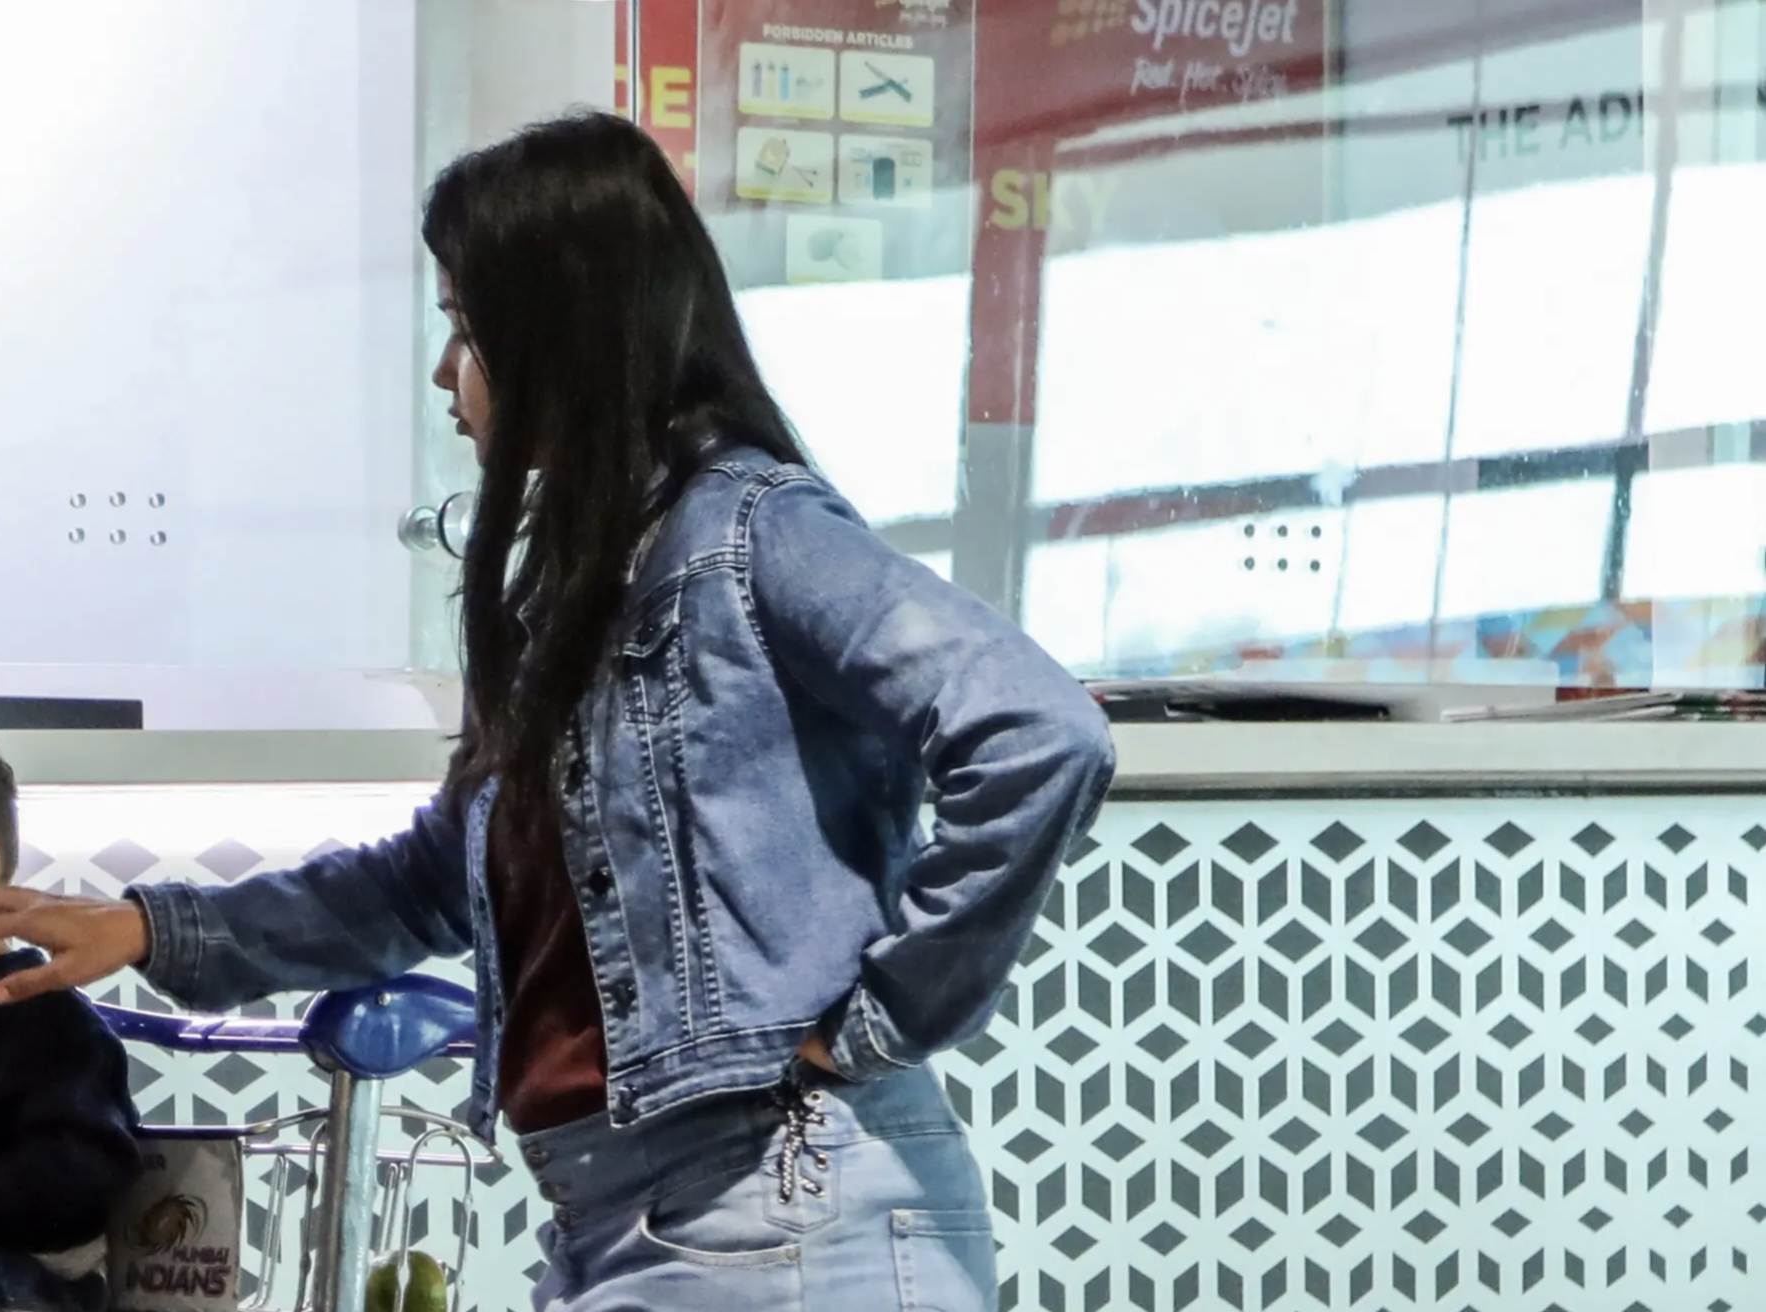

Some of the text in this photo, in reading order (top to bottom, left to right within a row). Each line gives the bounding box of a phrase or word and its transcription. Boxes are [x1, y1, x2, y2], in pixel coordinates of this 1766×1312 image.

[762, 23, 914, 49] FORBIDDEN ARTICLES
[1446, 82, 1643, 165] THE AD
[990, 168, 1118, 234] SKY
[125, 1263, 233, 1298] INDIANS
